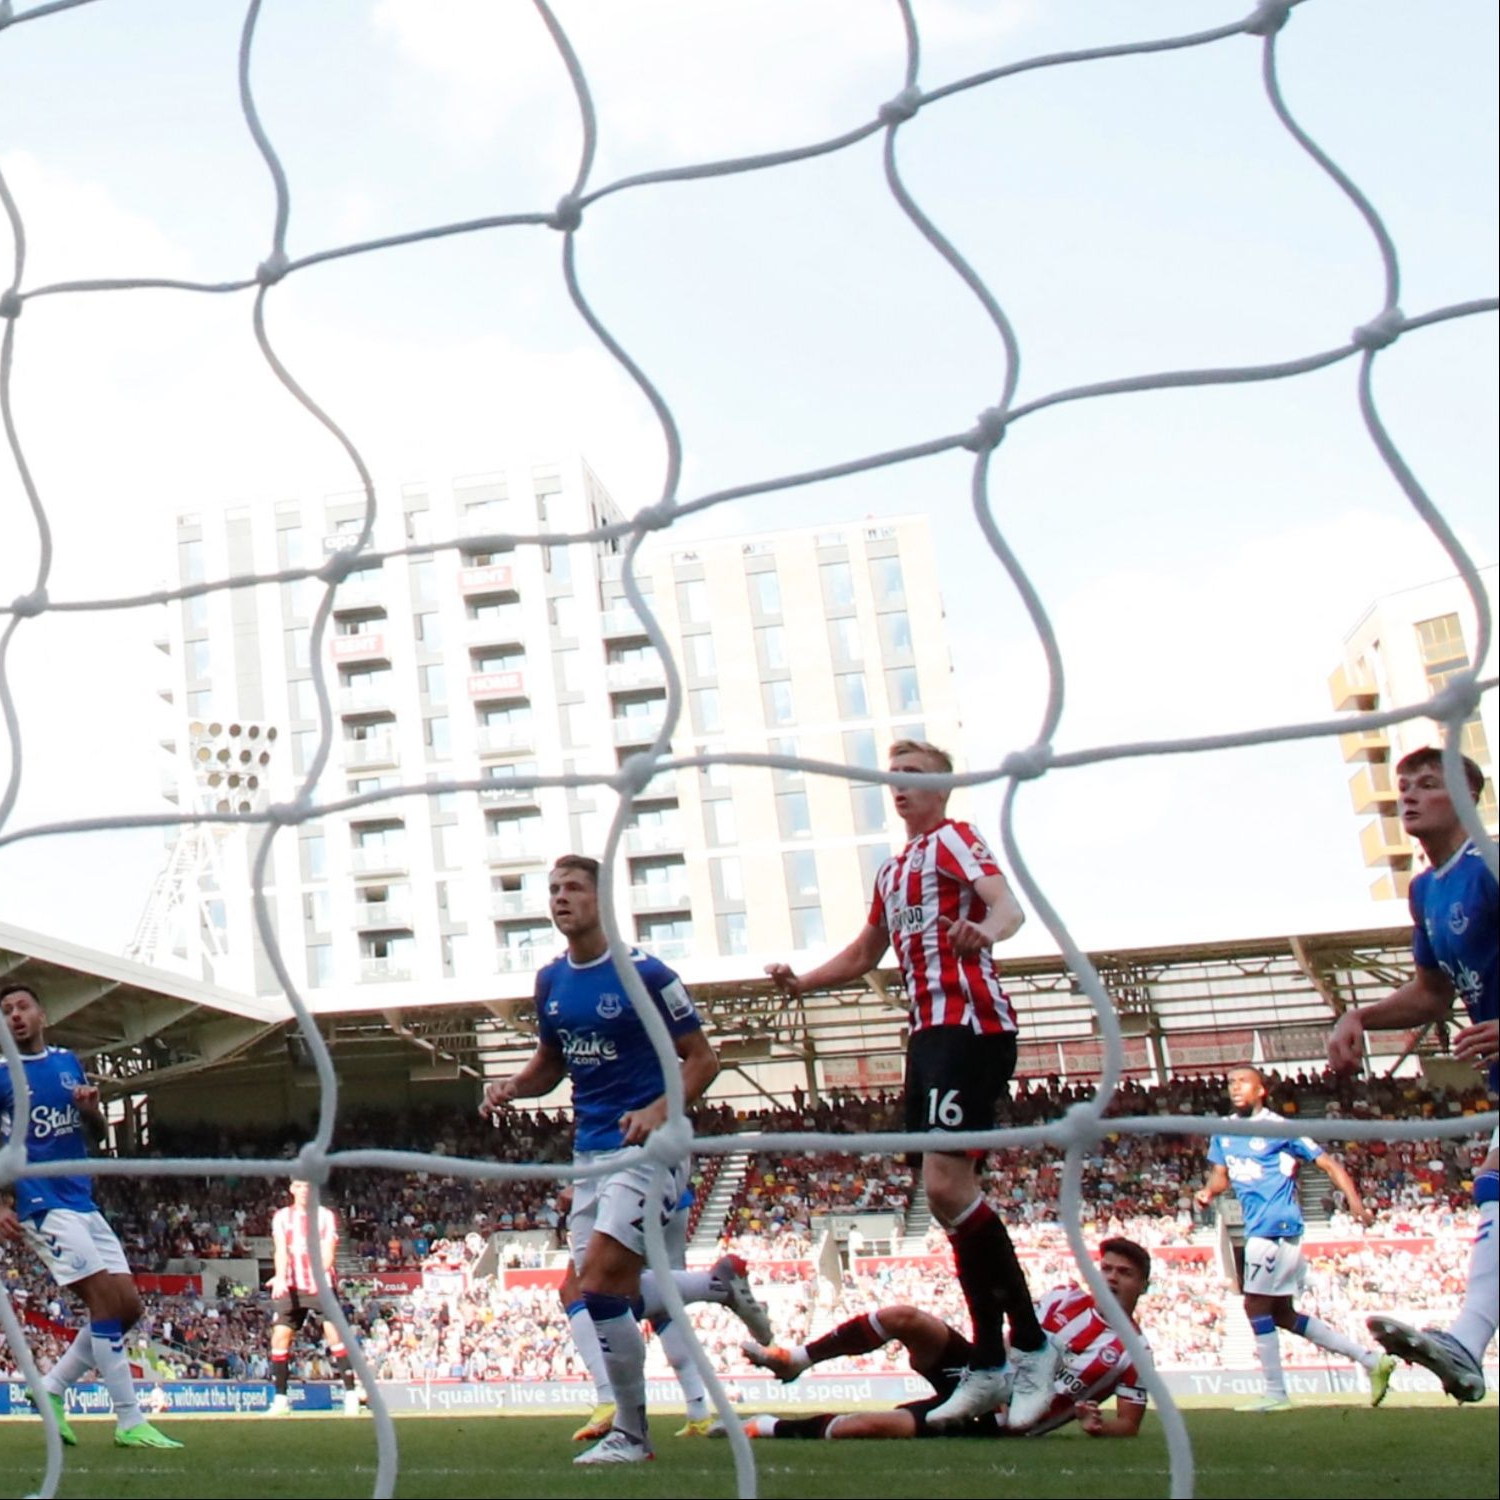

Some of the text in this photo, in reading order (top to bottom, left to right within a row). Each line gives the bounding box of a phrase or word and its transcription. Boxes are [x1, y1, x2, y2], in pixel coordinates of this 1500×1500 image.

[928, 1088, 963, 1126] 16
[511, 1383, 549, 1403] live
[553, 1386, 599, 1403] strea
[802, 1379, 872, 1402] spend
